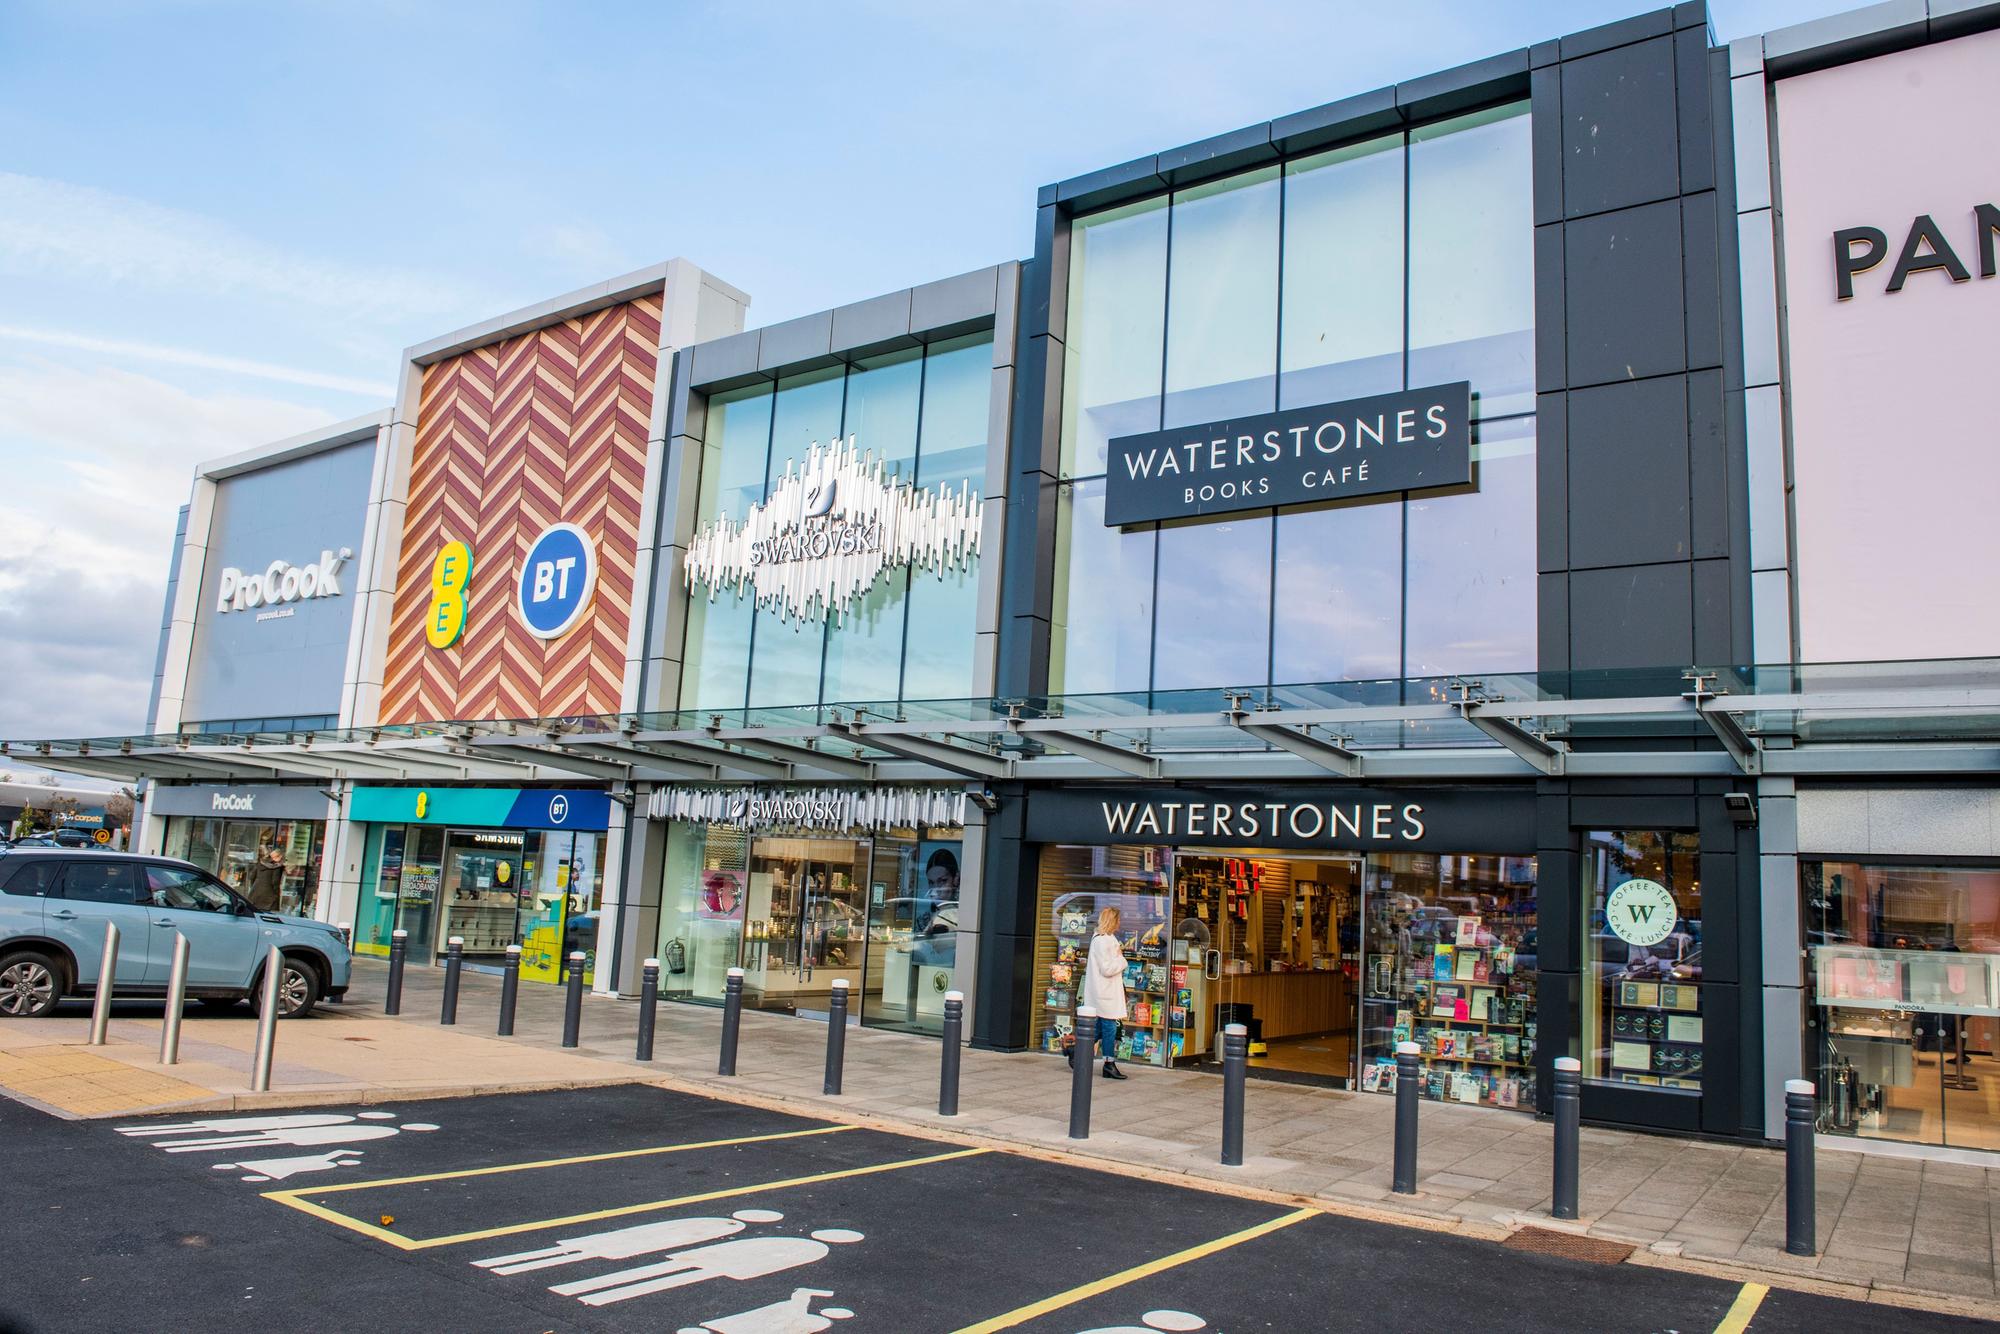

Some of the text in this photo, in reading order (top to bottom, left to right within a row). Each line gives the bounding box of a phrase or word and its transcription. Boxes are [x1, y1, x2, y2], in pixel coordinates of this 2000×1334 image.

[1124, 404, 1447, 480] WATERSTONES
[1184, 460, 1369, 503] BOOKS CAFÉ
[751, 521, 881, 566] SWAROVSKI
[217, 550, 347, 613] ProCook
[533, 556, 577, 603] BT
[212, 793, 253, 811] ProCook
[553, 803, 564, 815] BT
[751, 799, 843, 820] SWAROVSKI
[1101, 801, 1424, 841] WATERSTONES
[1611, 882, 1671, 908] COFFEE TEA
[1610, 915, 1673, 944] CAKE LUNCH
[1627, 904, 1656, 924] W
